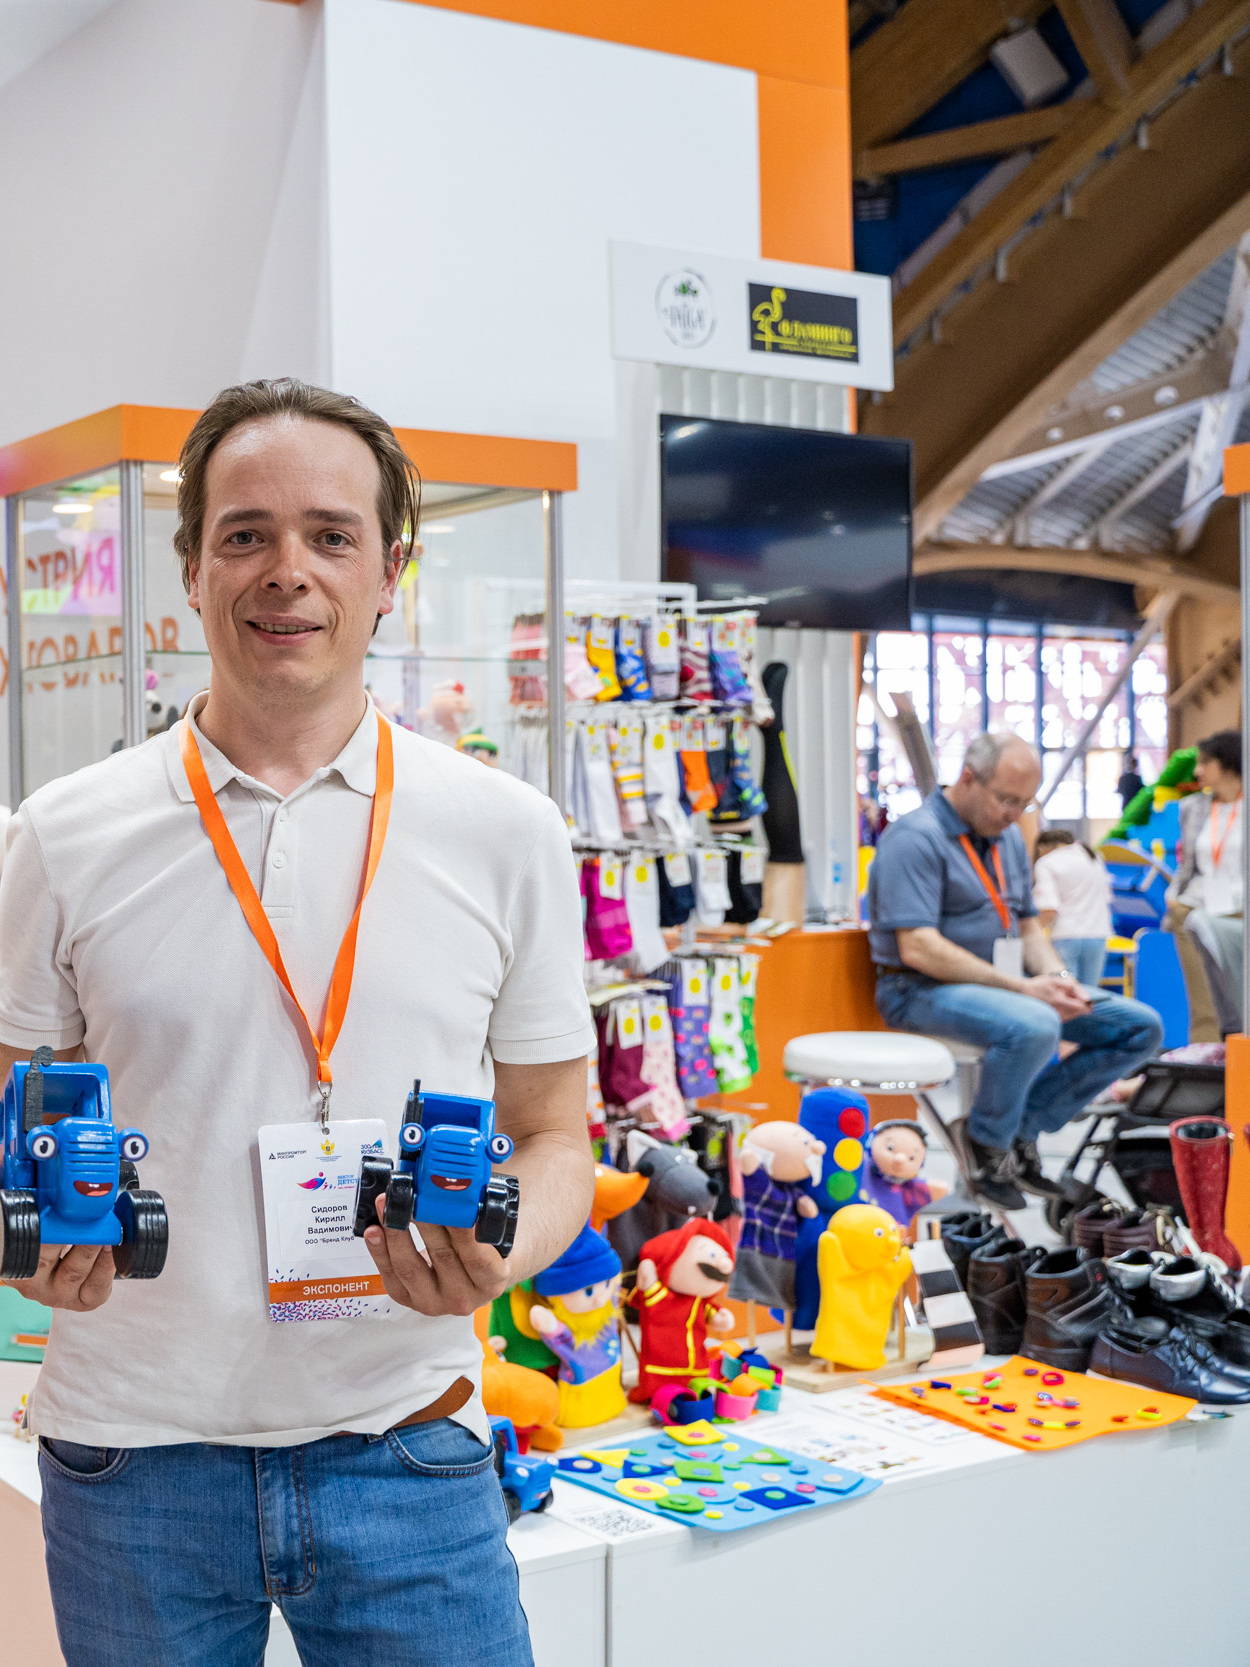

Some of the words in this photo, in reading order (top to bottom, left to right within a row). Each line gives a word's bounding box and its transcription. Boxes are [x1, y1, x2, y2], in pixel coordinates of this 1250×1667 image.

[337, 1178, 358, 1186] ДЕТСТ
[311, 1204, 348, 1214] Сидоров
[314, 1215, 346, 1224] Кирилл
[302, 1281, 370, 1296] ЭКСПОНЕНТ
